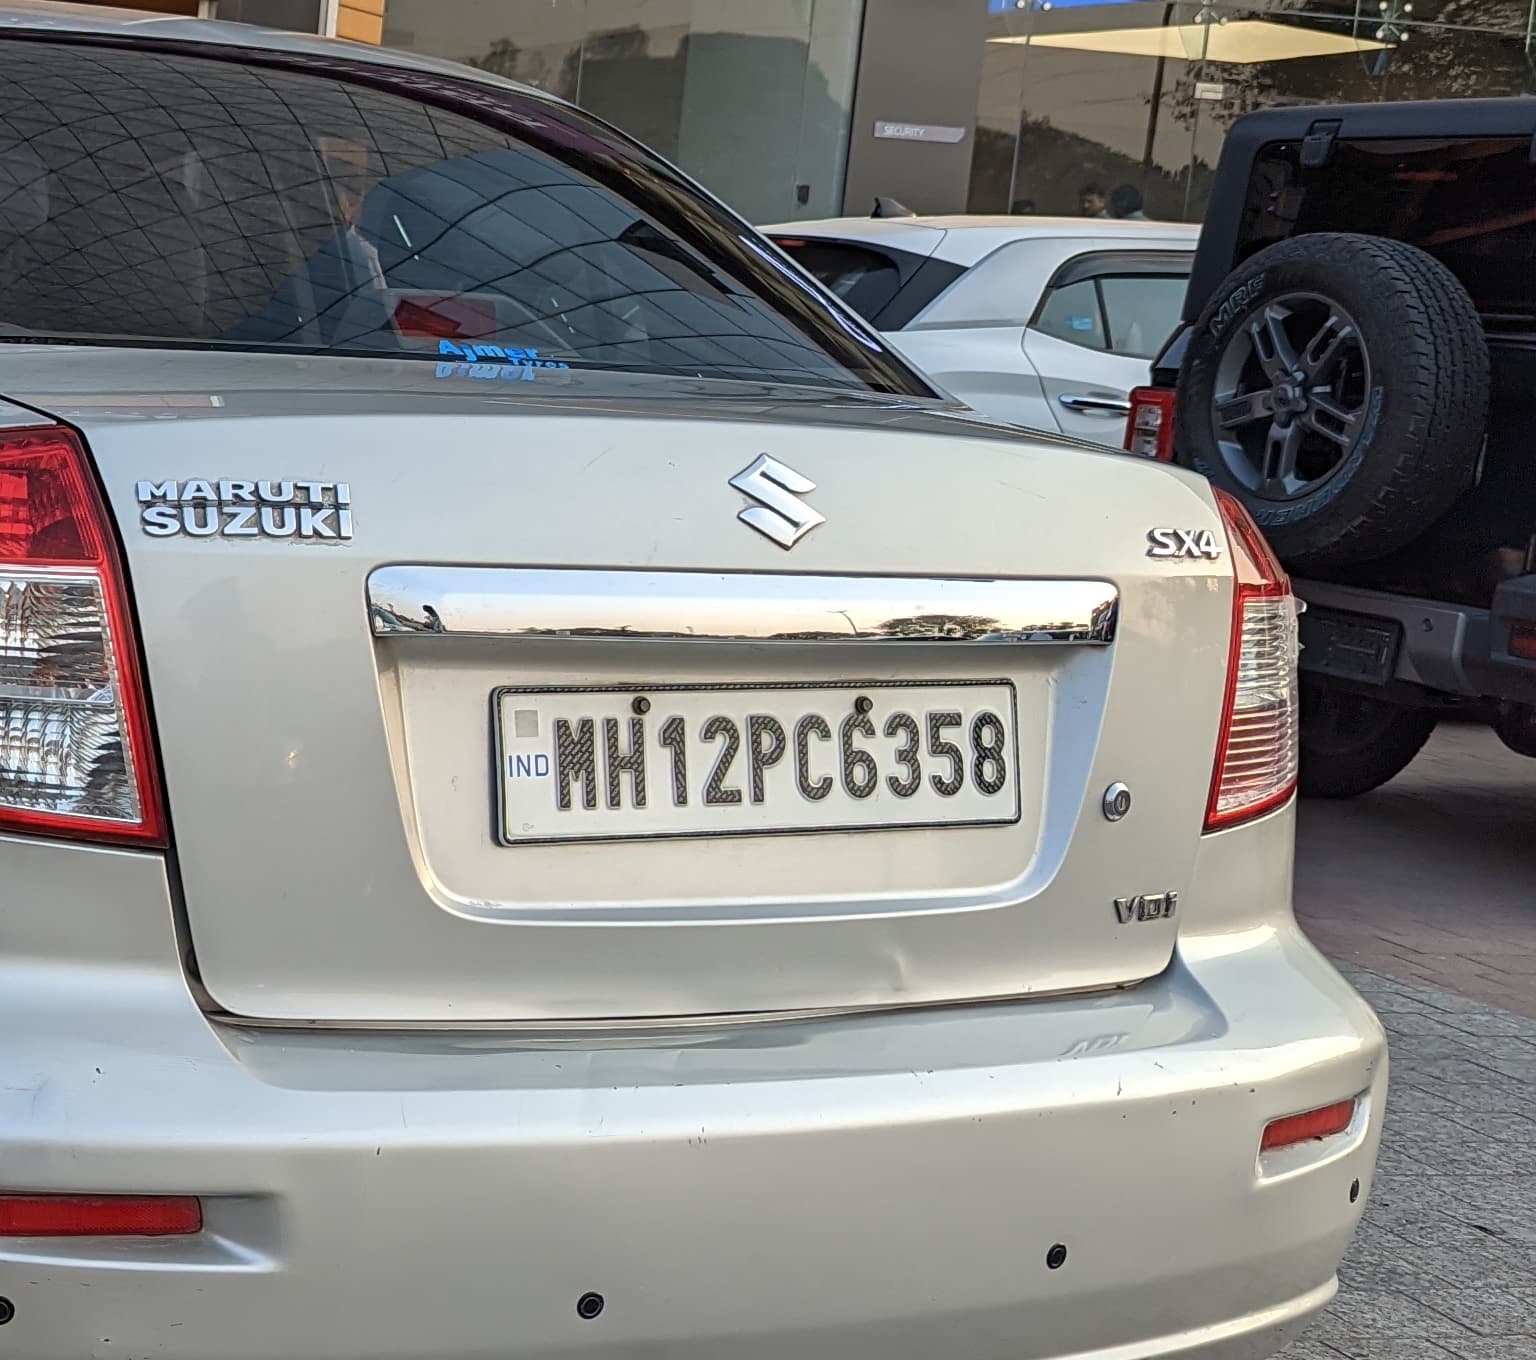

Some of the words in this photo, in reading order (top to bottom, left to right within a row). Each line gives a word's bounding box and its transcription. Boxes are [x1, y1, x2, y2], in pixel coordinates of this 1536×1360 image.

[437, 340, 539, 362] Ajmer
[136, 479, 351, 505] MARUTI
[140, 505, 353, 540] SUZUKI
[1146, 528, 1225, 560] SX4
[507, 753, 550, 778] IND
[552, 708, 1009, 811] MH12PC6358
